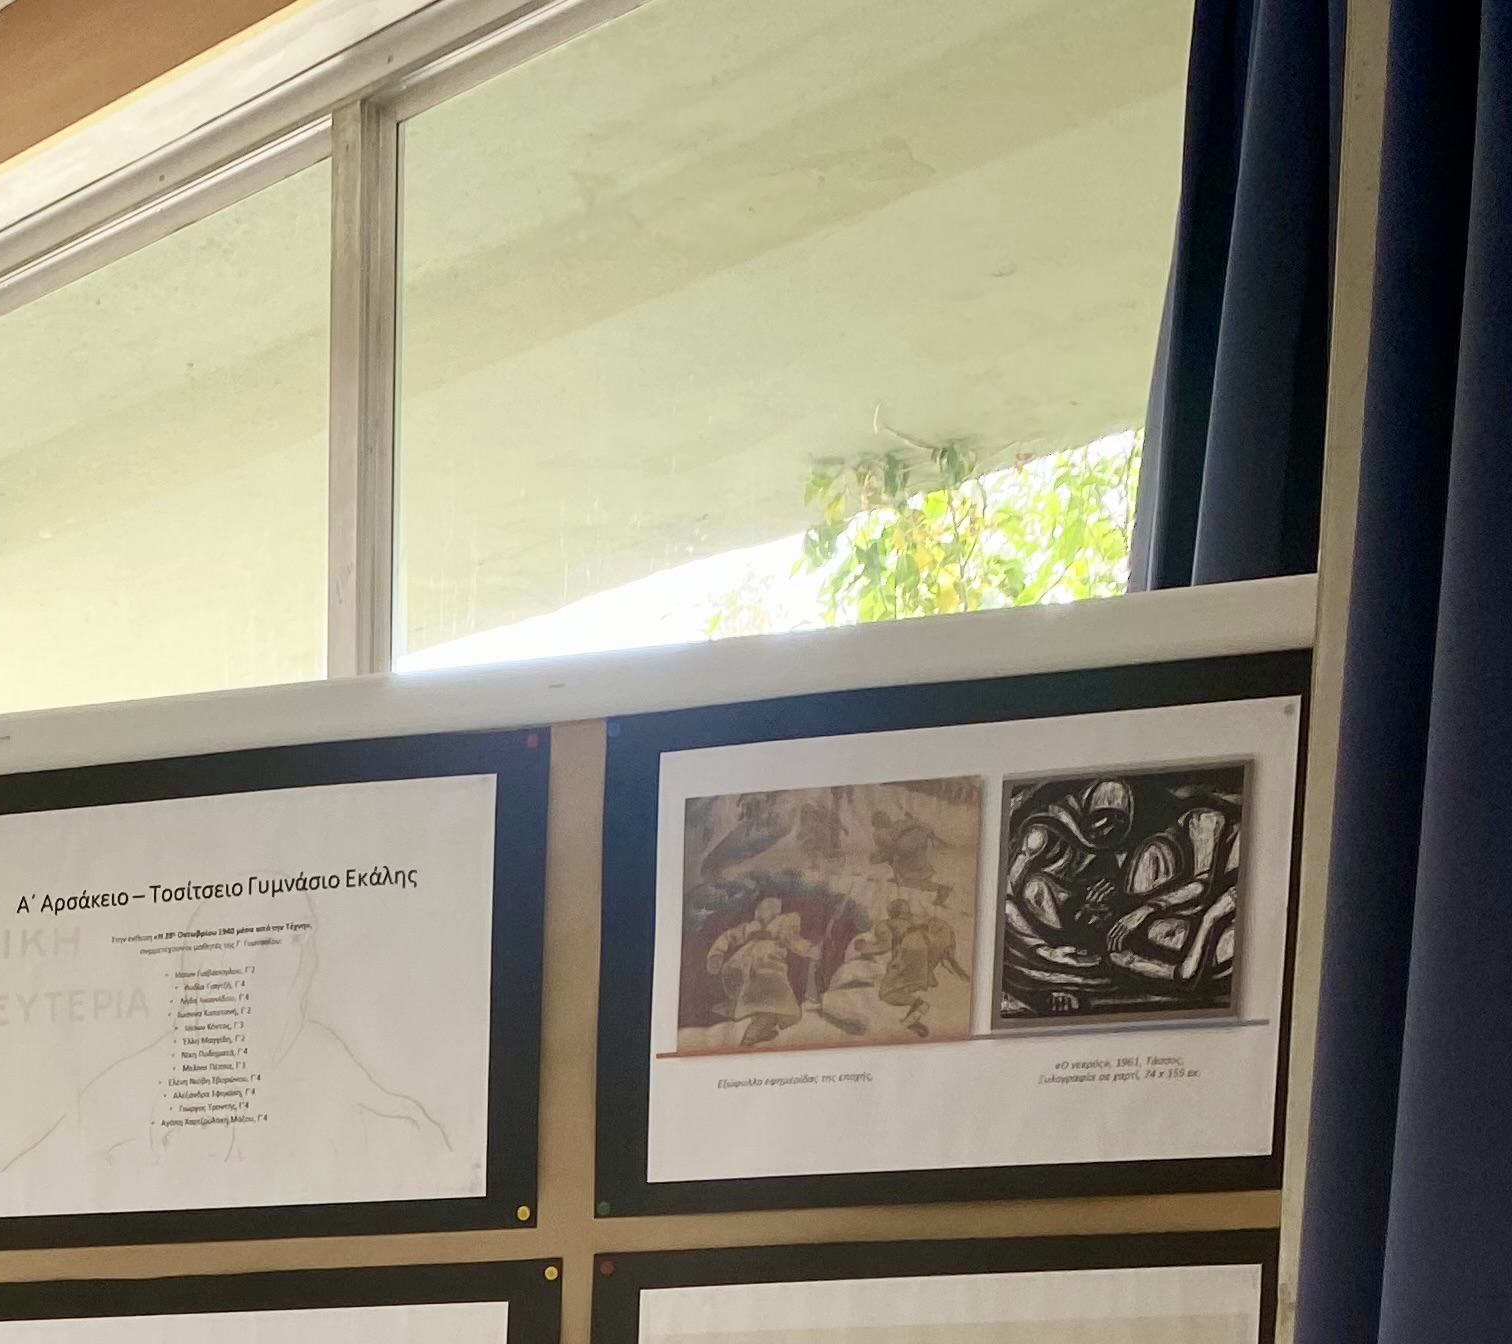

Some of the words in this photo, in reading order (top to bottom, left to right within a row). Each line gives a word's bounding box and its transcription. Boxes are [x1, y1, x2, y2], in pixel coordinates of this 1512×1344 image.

[40, 889, 129, 916] Αρσάκειο
[148, 880, 243, 903] Τοσίτσειο
[248, 870, 340, 898] Γυμνάσιο
[345, 865, 417, 888] Εκάλης
